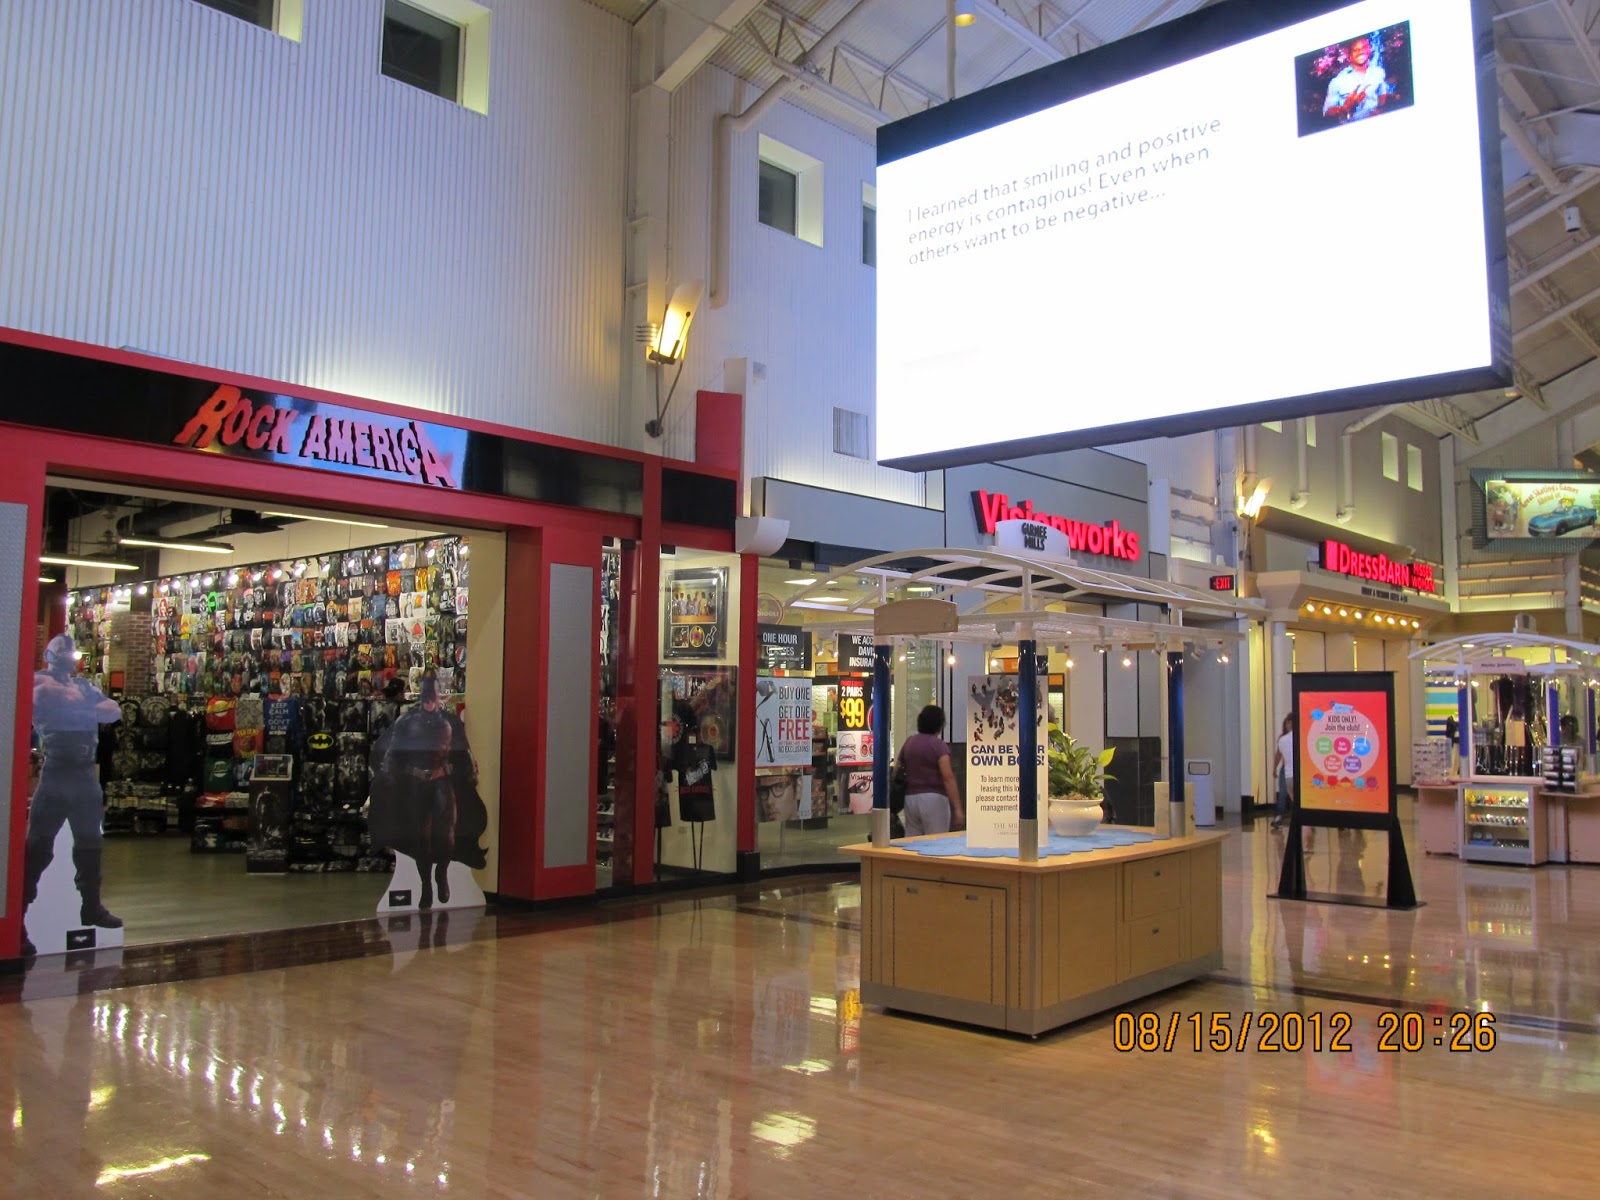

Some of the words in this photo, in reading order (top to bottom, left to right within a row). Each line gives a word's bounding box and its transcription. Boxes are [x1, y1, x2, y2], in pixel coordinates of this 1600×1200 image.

[918, 188, 978, 221] learned
[983, 179, 1018, 200] that
[1023, 163, 1089, 190] smiling
[1096, 141, 1132, 168] and
[1138, 119, 1221, 159] positive
[908, 218, 965, 244] energy
[969, 211, 982, 227] is
[986, 176, 1093, 222] contagious!
[1099, 166, 1146, 190] Even
[1152, 147, 1210, 174] when
[908, 242, 960, 265] others
[964, 227, 1007, 251] want
[1012, 222, 1031, 237] to
[1035, 214, 1058, 231] be
[1063, 188, 1166, 220] negative...
[173, 384, 298, 454] ROCK
[299, 413, 457, 488] AMERICA
[1215, 576, 1231, 590] EXIT
[762, 632, 777, 644] ONE
[778, 633, 798, 645] HOUR
[852, 635, 862, 645] WE
[862, 635, 874, 646] ACC
[849, 656, 875, 668] INSURA
[778, 686, 794, 700] BUY
[795, 687, 810, 700] ONE
[841, 686, 846, 697] 2
[778, 705, 793, 719] GET
[795, 706, 810, 719] ONE
[840, 698, 865, 728] $99
[1328, 715, 1340, 723] KIDS
[778, 719, 811, 741] FREE
[971, 744, 995, 754] CAN
[998, 745, 1013, 754] BE
[1016, 745, 1045, 754] YR
[971, 755, 1003, 766] OWN
[1007, 755, 1045, 766] BS!
[988, 775, 1003, 783] learn
[980, 785, 1001, 793] leasing
[1002, 785, 1013, 793] this
[975, 795, 995, 803] please
[980, 804, 1018, 813] management
